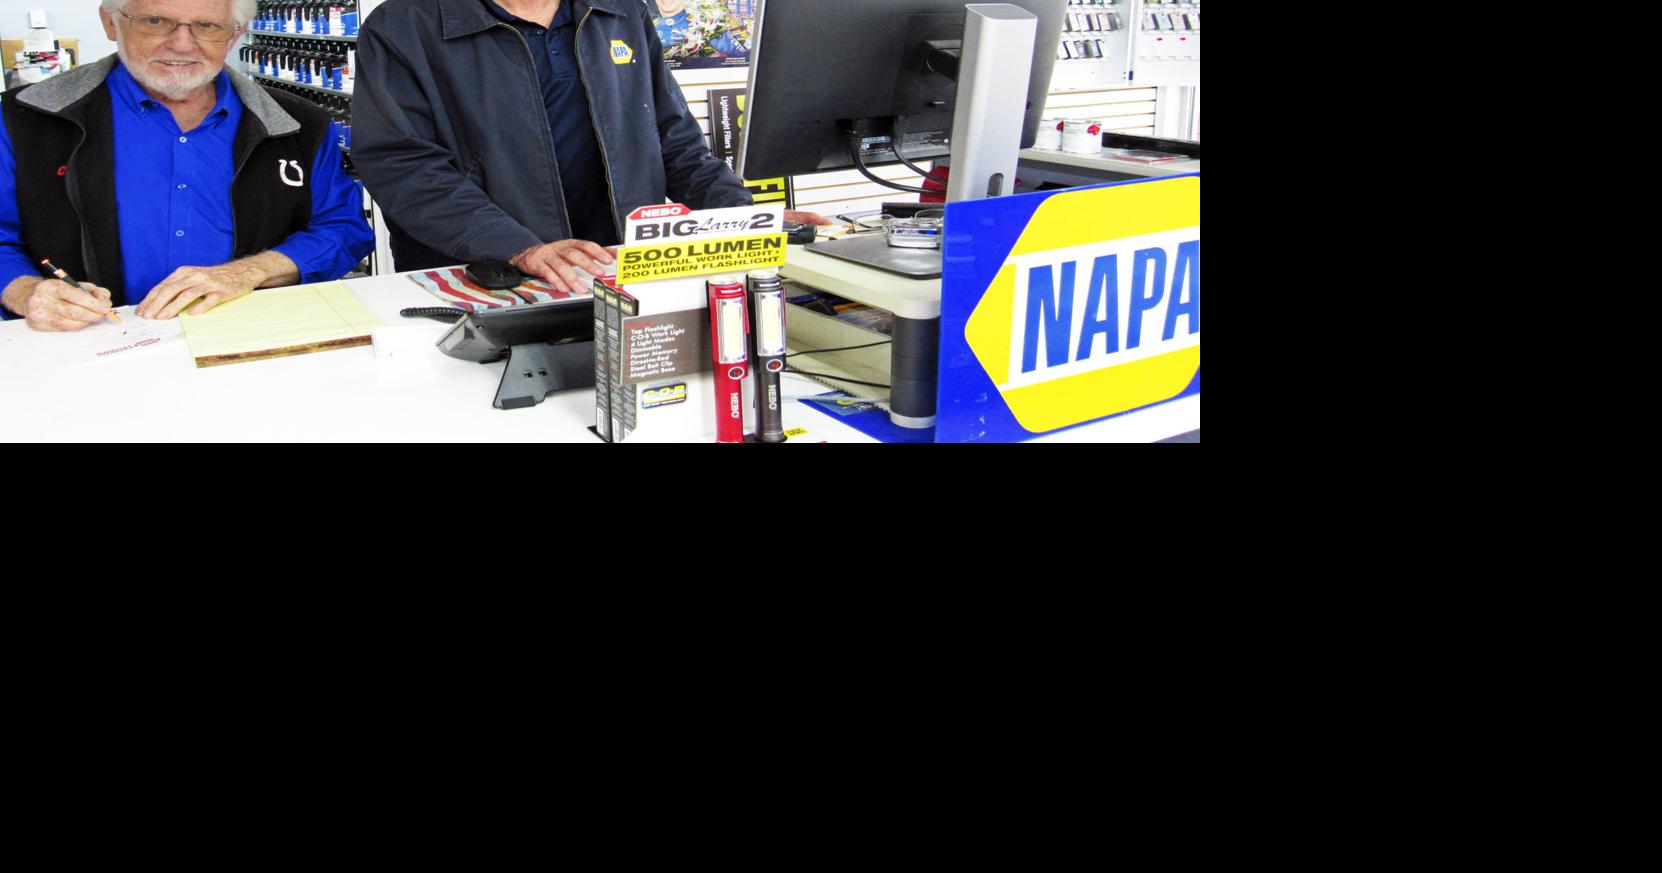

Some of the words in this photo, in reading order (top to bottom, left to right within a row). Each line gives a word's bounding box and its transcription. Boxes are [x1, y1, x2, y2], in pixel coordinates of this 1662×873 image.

[720, 96, 730, 130] Lightweight
[640, 206, 682, 218] NEBO
[634, 220, 698, 240] BIG
[694, 217, 750, 234] Larry
[749, 213, 774, 230] 2
[622, 258, 694, 271] POWERFUL
[696, 253, 732, 262] WORK
[624, 246, 682, 264] 500
[688, 237, 782, 256] LUMEN
[622, 270, 650, 279] 200
[654, 264, 698, 275] LUMEN
[702, 256, 780, 270] FLASHLIGHT
[1021, 239, 1200, 374] NAPA
[644, 324, 674, 333] Flashlight
[730, 392, 740, 418] NEBO
[768, 384, 778, 410] NEBO
